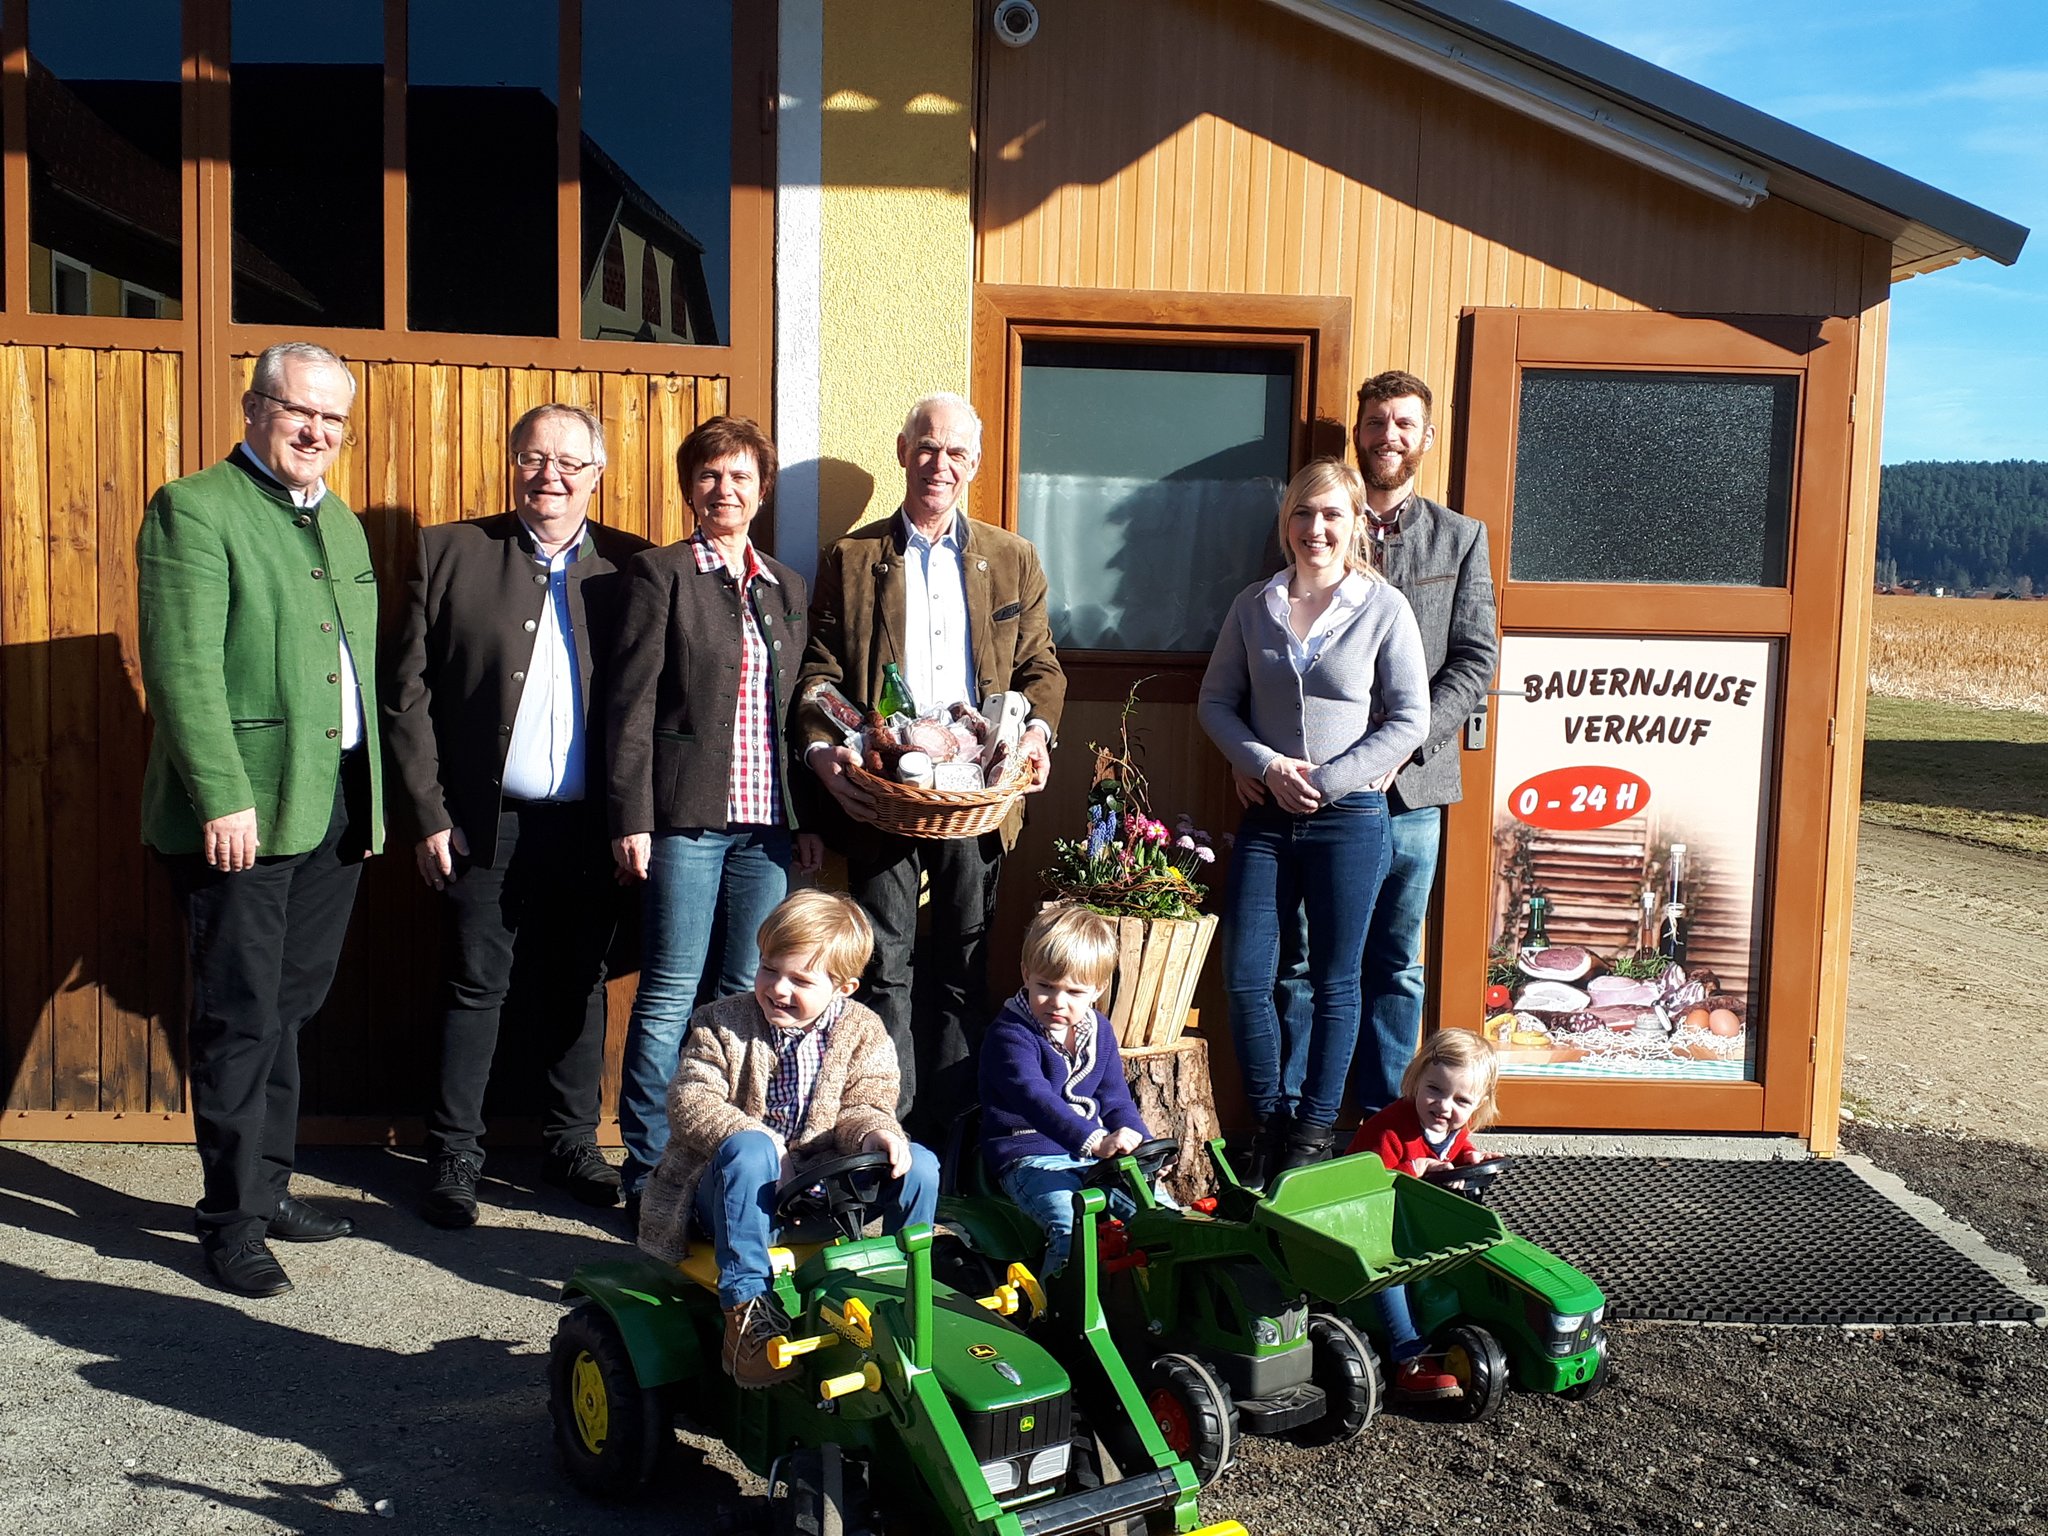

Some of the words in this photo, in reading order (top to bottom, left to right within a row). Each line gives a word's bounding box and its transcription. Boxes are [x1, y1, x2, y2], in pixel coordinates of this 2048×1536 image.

[1524, 668, 1756, 706] BAUERNJAUSE
[1565, 715, 1711, 745] VERKAUF
[1519, 788, 1539, 815] 0
[1547, 799, 1560, 809] -
[1570, 785, 1607, 812] 24
[1616, 782, 1639, 810] H
